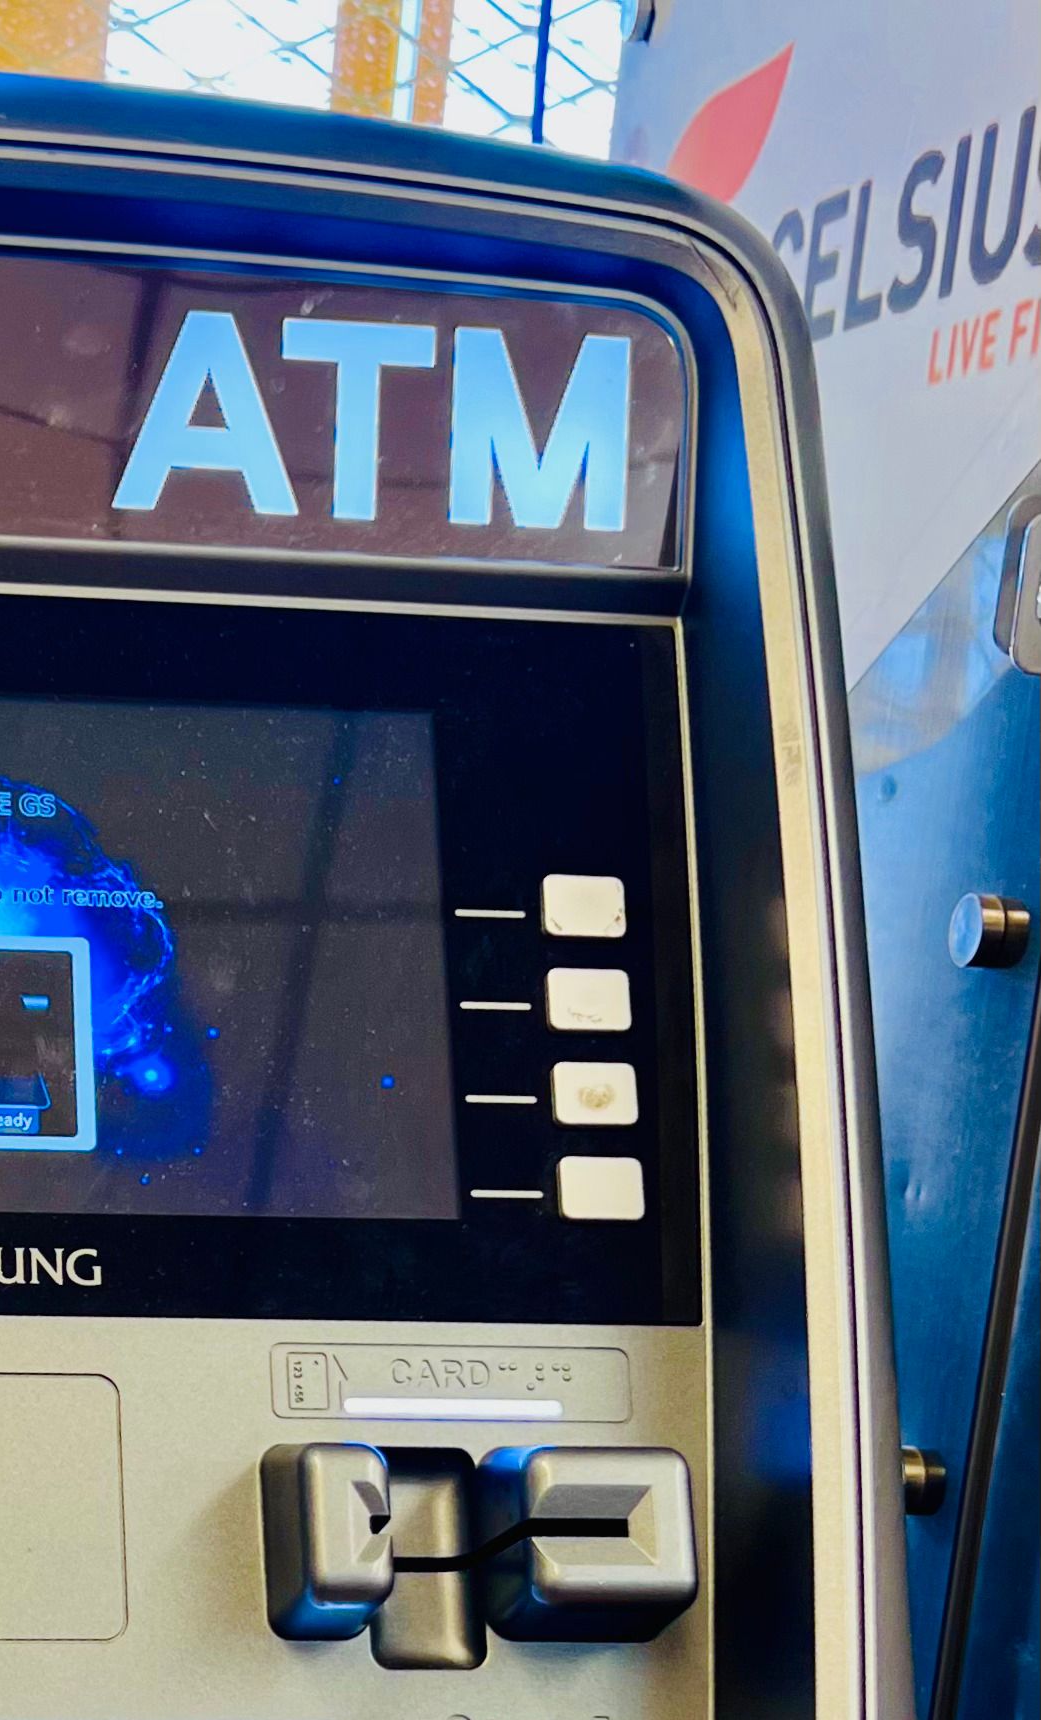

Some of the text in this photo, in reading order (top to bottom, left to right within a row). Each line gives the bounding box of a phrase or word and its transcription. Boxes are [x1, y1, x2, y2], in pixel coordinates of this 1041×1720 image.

[928, 309, 991, 386] LIVE
[112, 310, 632, 531] ATM
[18, 790, 57, 817] GS
[13, 885, 55, 905] not
[61, 888, 165, 909] remove.
[390, 1357, 492, 1388] CARD
